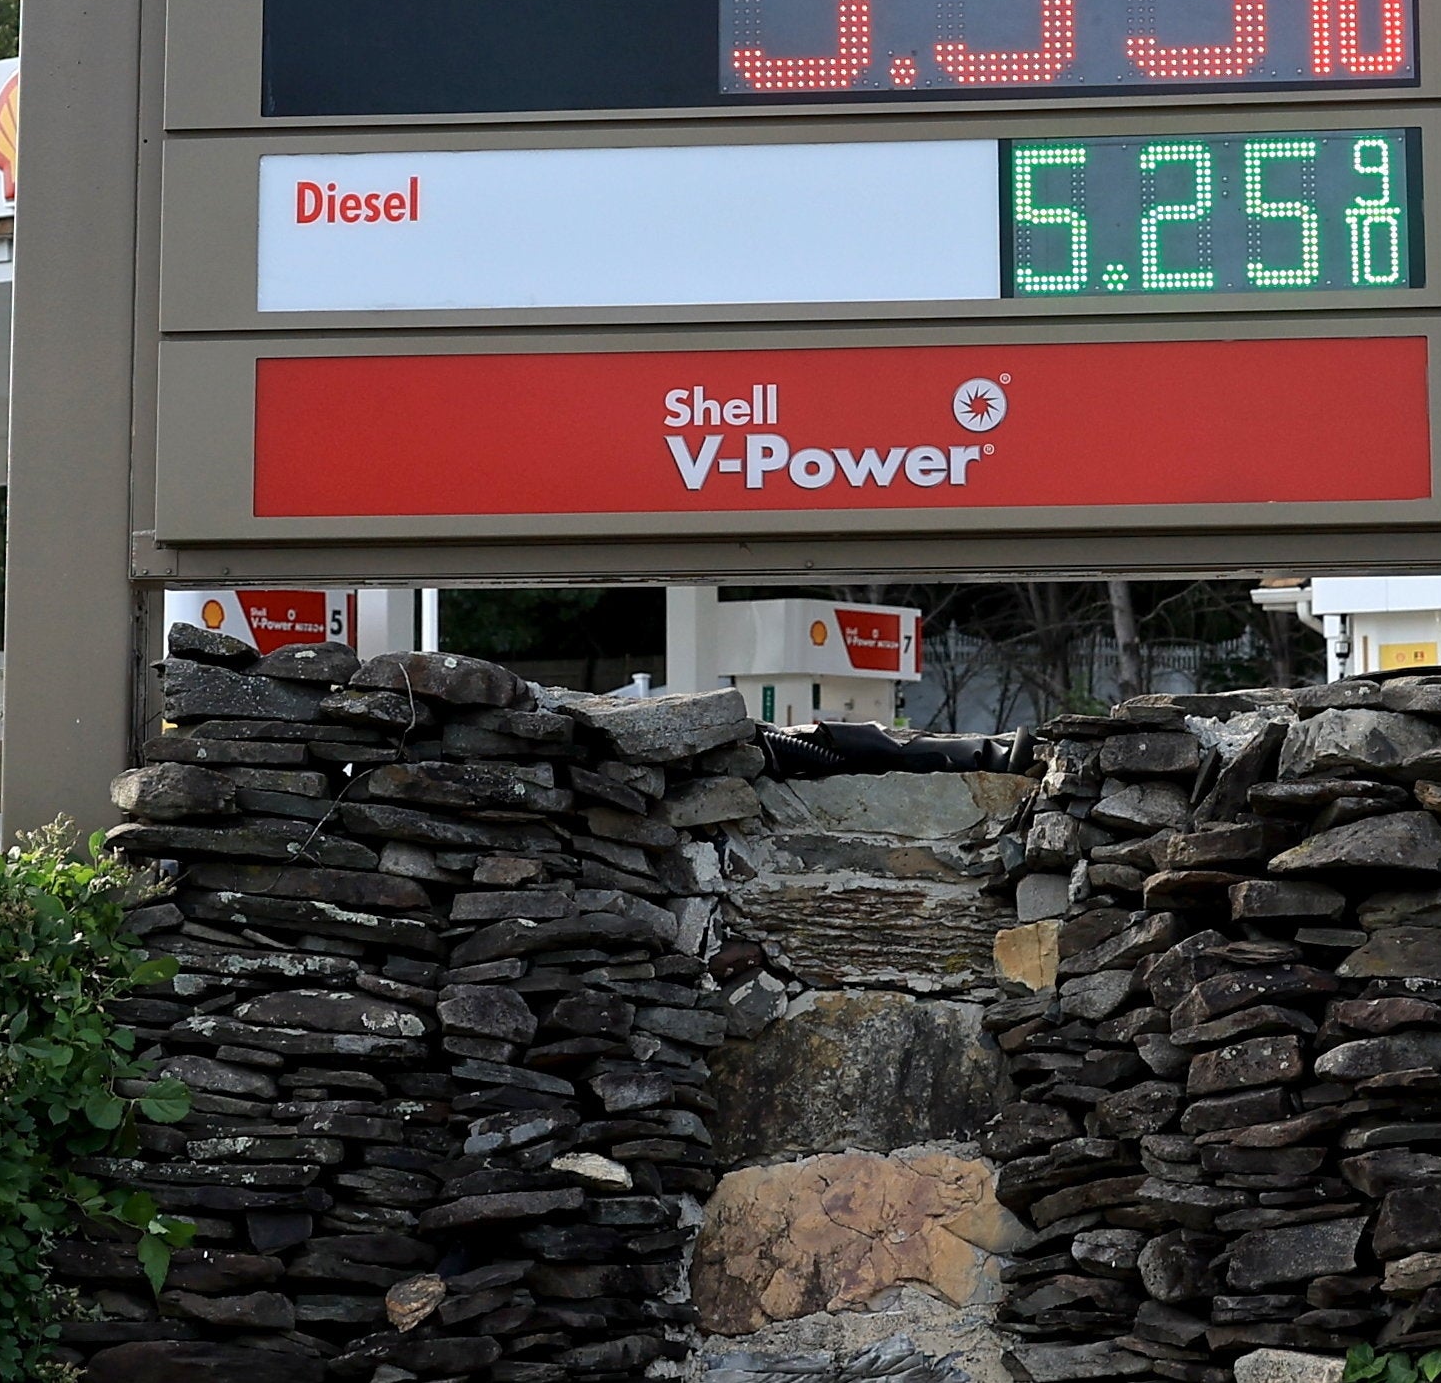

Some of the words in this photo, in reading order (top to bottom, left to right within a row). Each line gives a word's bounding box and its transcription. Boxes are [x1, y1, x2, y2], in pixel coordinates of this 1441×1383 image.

[296, 176, 419, 224] Diesel
[1015, 141, 1319, 291] 5.25
[663, 383, 777, 427] Shell
[663, 433, 982, 490] V-Power
[330, 610, 343, 635] 5
[903, 635, 912, 654] 7
